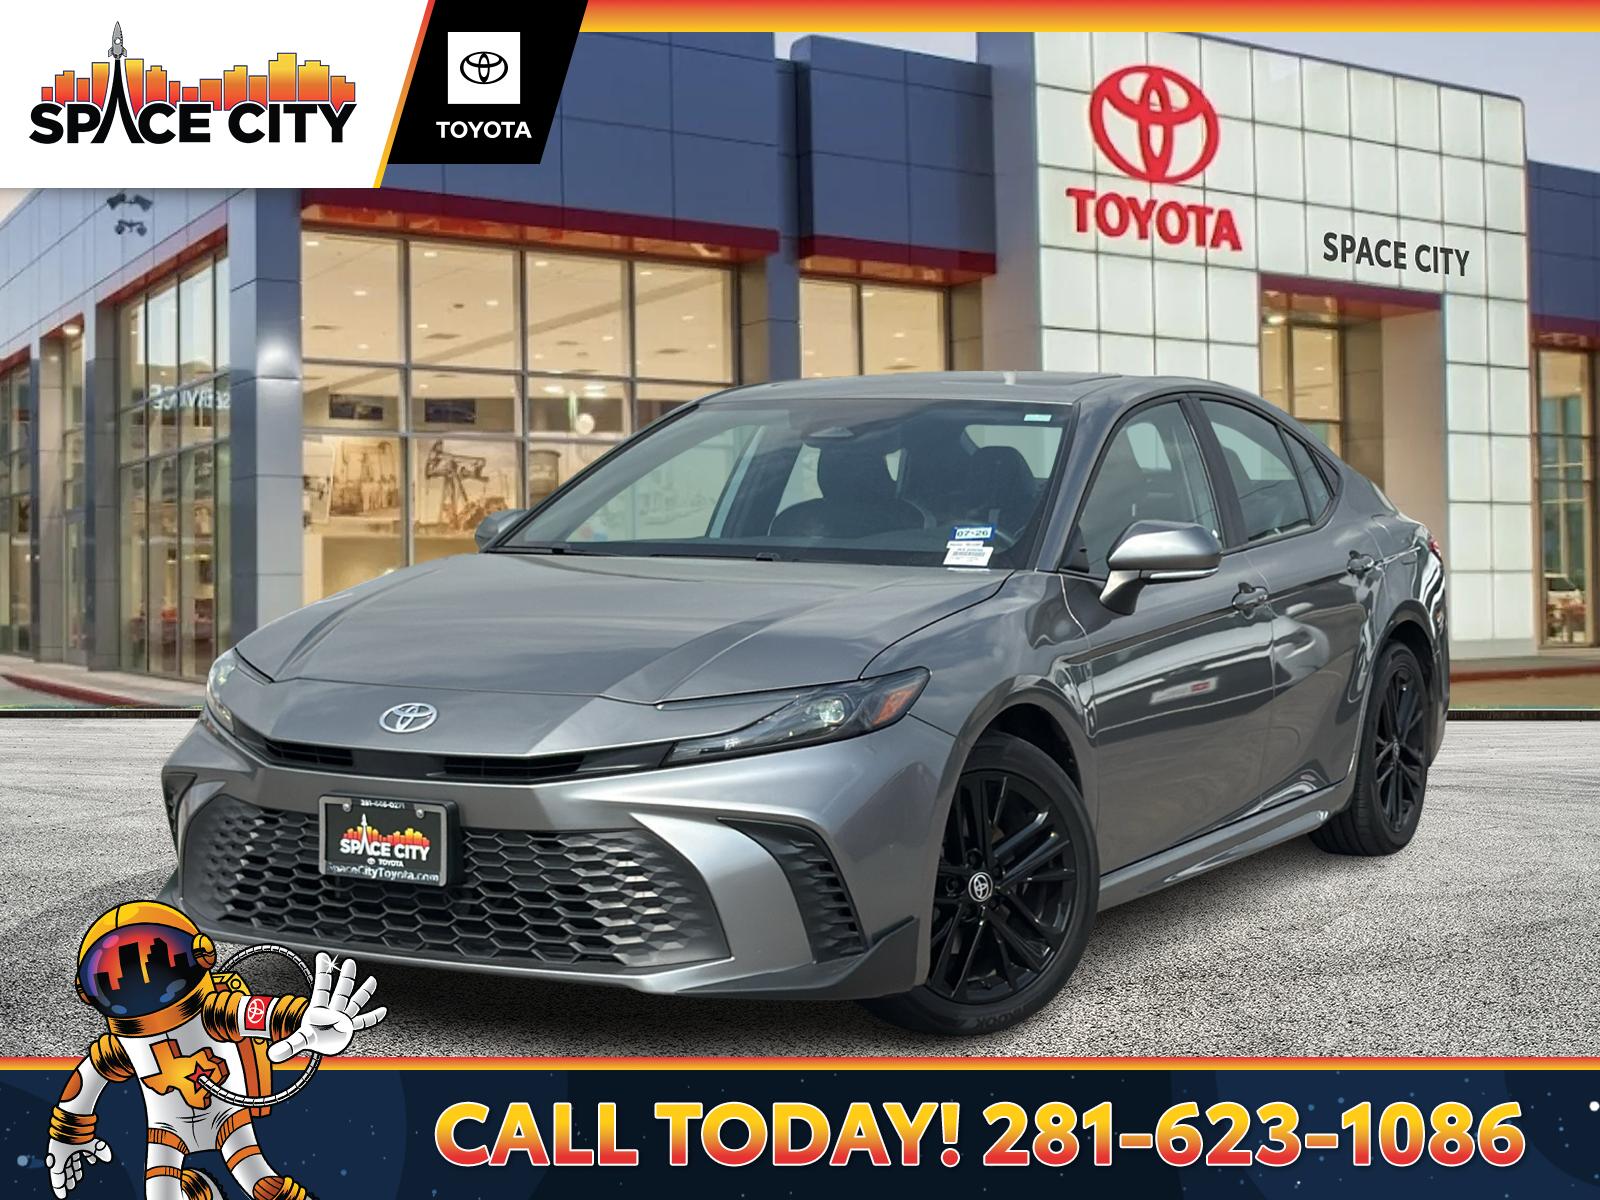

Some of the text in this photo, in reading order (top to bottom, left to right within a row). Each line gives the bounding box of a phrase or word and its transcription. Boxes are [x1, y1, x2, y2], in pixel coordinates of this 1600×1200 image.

[1065, 188, 1243, 252] TOYOTA
[1322, 231, 1471, 277] SPACE CITY
[340, 831, 430, 861] SPACE CITY
[378, 858, 404, 867] TOYOTA
